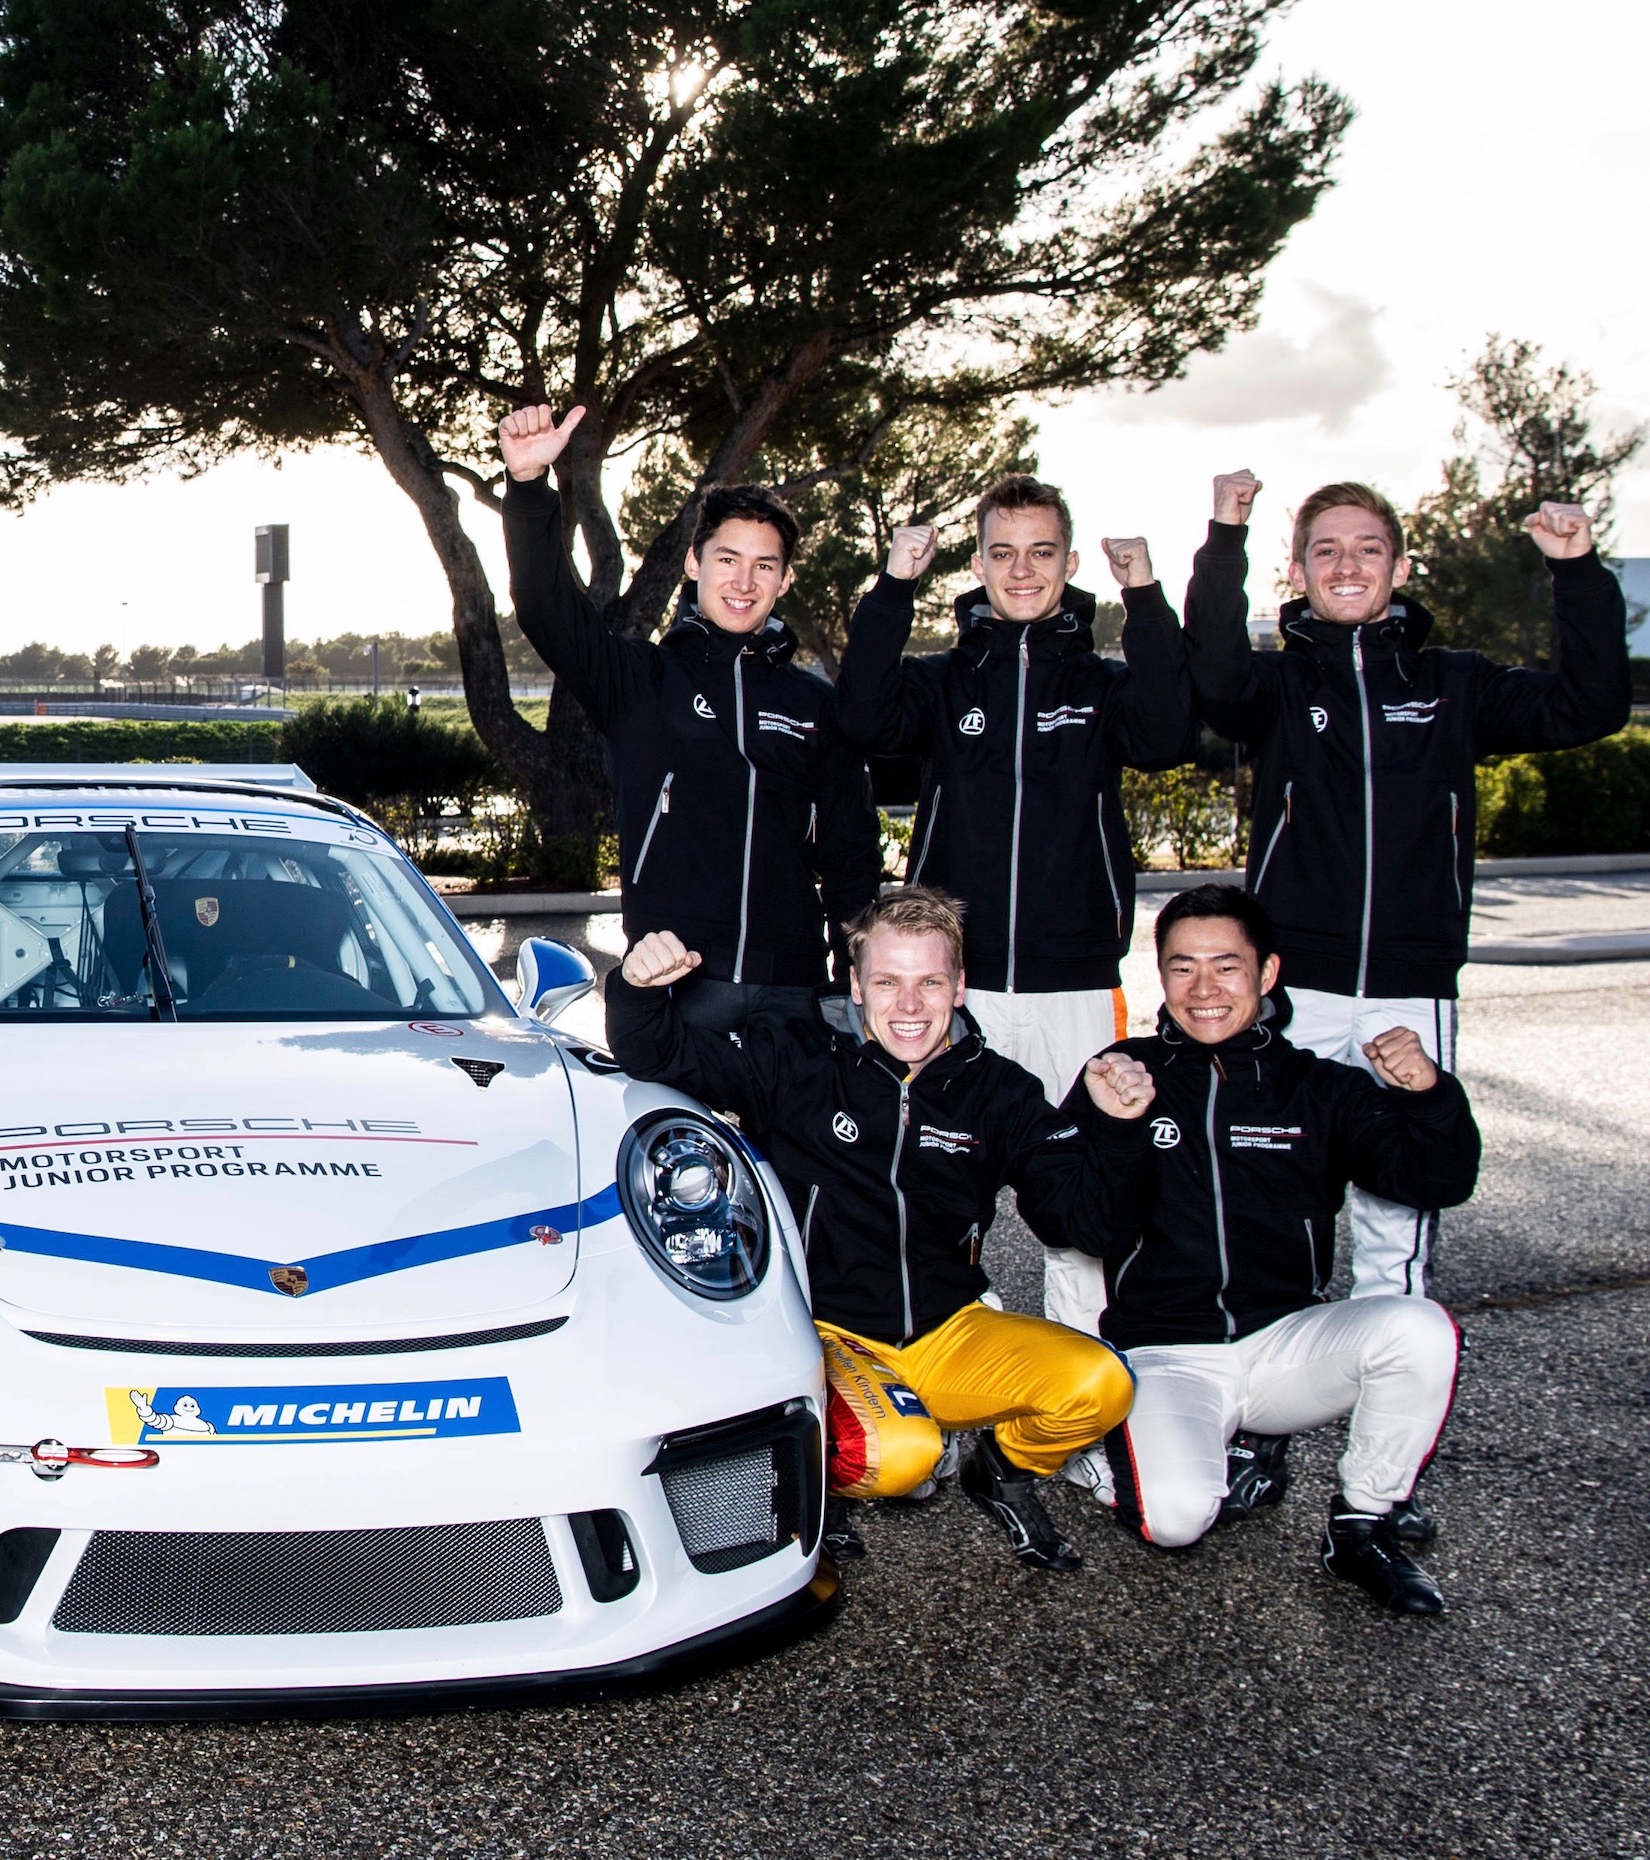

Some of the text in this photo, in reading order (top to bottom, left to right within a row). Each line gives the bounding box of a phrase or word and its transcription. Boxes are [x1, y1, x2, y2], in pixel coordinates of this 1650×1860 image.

[960, 711, 985, 732] ZF
[339, 826, 379, 846] 70
[834, 1115, 858, 1140] ZF
[1149, 1121, 1179, 1145] ZF
[1230, 1125, 1302, 1134] PORSCHE
[1230, 1135, 1272, 1143] MOTORSPORT
[1253, 1142, 1292, 1150] PROGRAMME
[0, 1145, 245, 1172] MOTORSPORT
[3, 1162, 383, 1190] JUNIOR PROGRAMME
[854, 1374, 887, 1419] Kindern
[227, 1396, 483, 1426] MICHELIN
